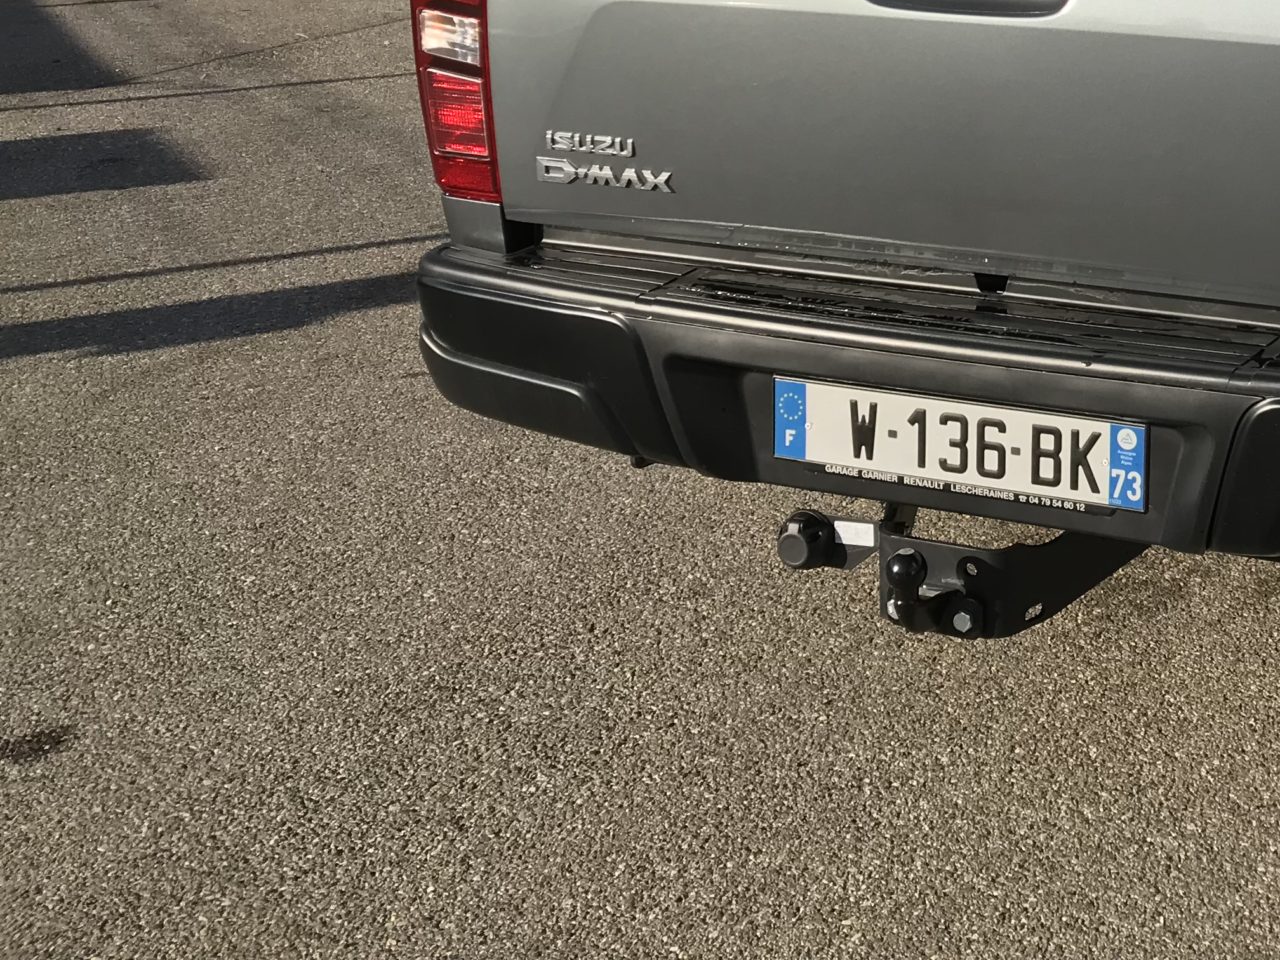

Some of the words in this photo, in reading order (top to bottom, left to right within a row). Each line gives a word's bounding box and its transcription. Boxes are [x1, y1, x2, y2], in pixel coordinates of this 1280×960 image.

[545, 130, 635, 157] ISUZU
[535, 156, 674, 193] D-MAX
[784, 429, 796, 447] F
[849, 398, 1102, 494] W-136-BK
[825, 464, 859, 477] GARAGE
[861, 470, 898, 483] GARNIER
[903, 476, 945, 490] RENAULT
[950, 482, 1015, 501] LESCHERAINES
[1028, 495, 1039, 505] 04
[1040, 497, 1051, 506] 79
[1052, 499, 1063, 508] 54
[1063, 501, 1074, 510] 60
[1075, 503, 1086, 512] 12
[1111, 468, 1142, 502] 73
